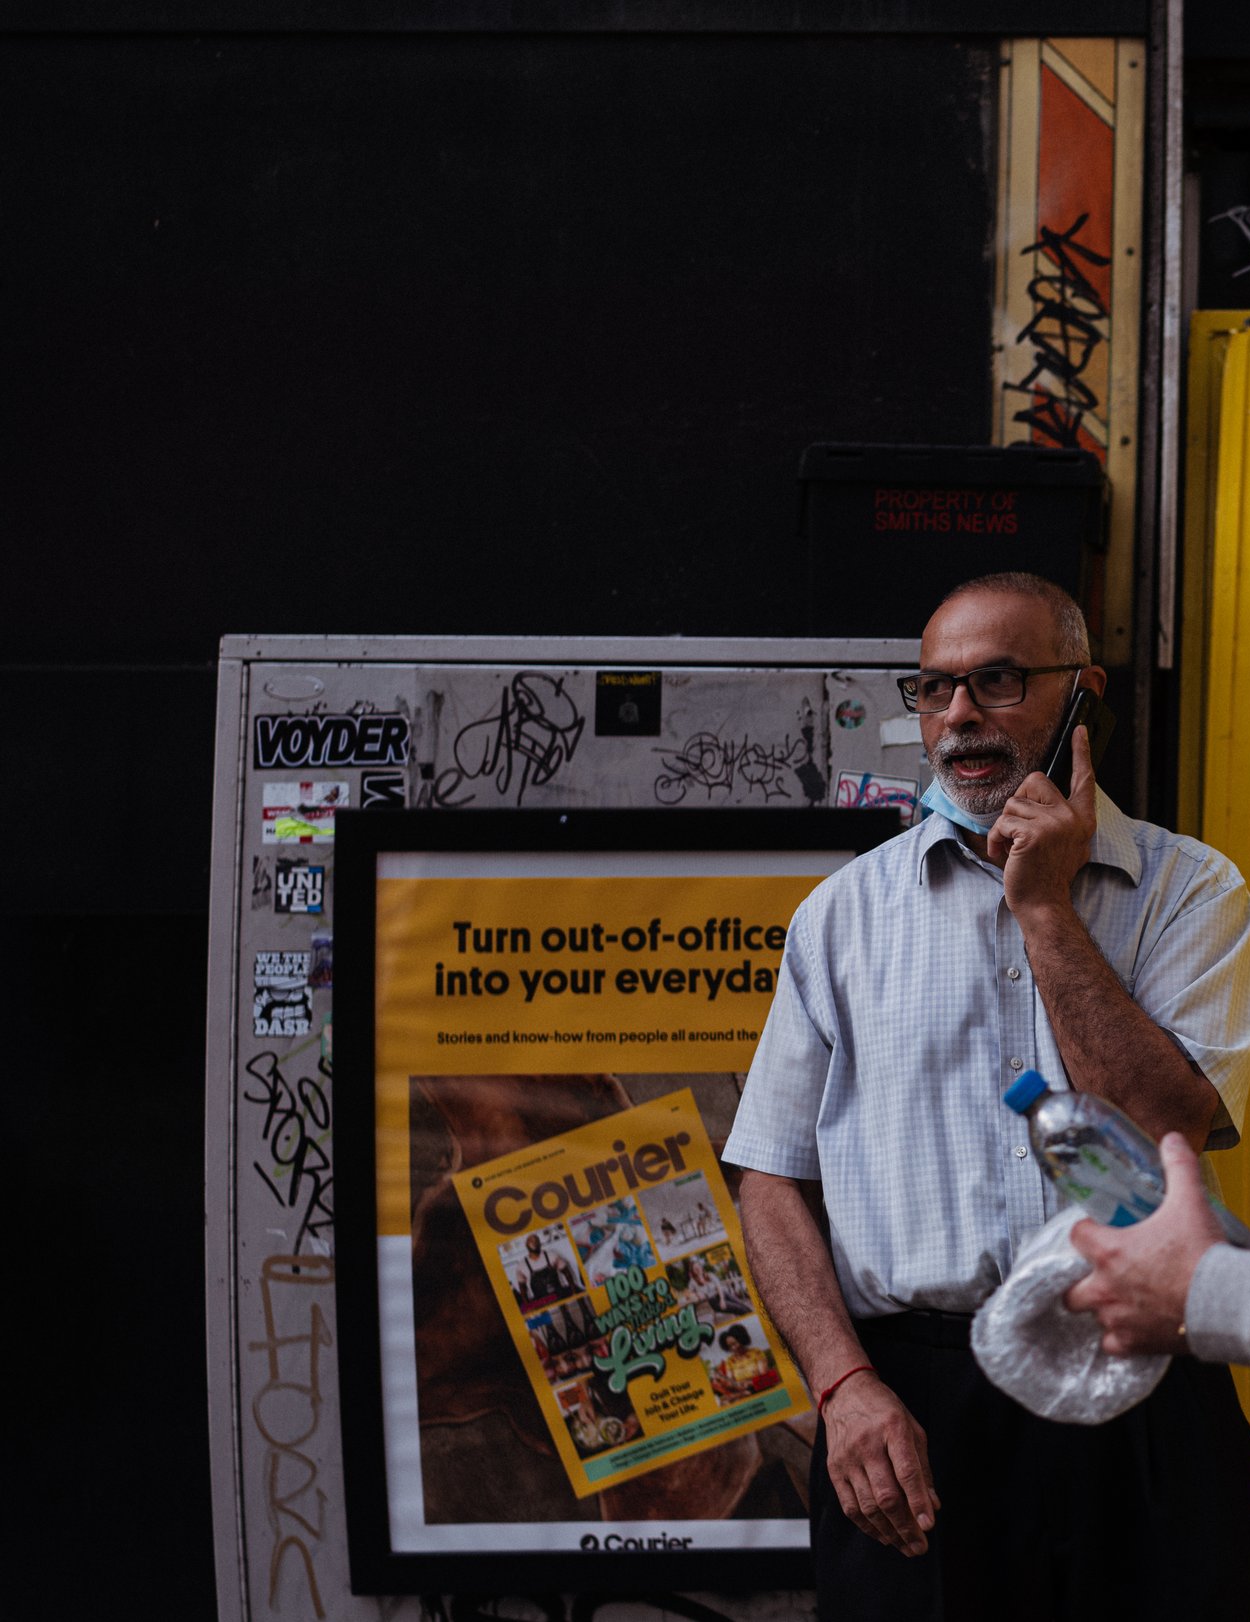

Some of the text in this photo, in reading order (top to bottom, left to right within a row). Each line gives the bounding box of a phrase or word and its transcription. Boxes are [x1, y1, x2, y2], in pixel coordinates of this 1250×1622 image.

[874, 488, 1019, 510] PROPERTY OF
[873, 511, 1019, 535] SMITHS NEWS
[256, 717, 410, 768] VOYDER
[453, 917, 787, 953] Turn out-of-office
[255, 963, 310, 975] PEOPLE
[435, 962, 510, 996] into
[520, 969, 606, 1002] your
[437, 1029, 758, 1045] Stories and know-how from people all around the
[484, 1132, 692, 1235] Courier
[605, 1264, 646, 1305] 100
[594, 1293, 644, 1334] WAYS
[594, 1304, 714, 1394] Living
[603, 1532, 693, 1550] Courier
